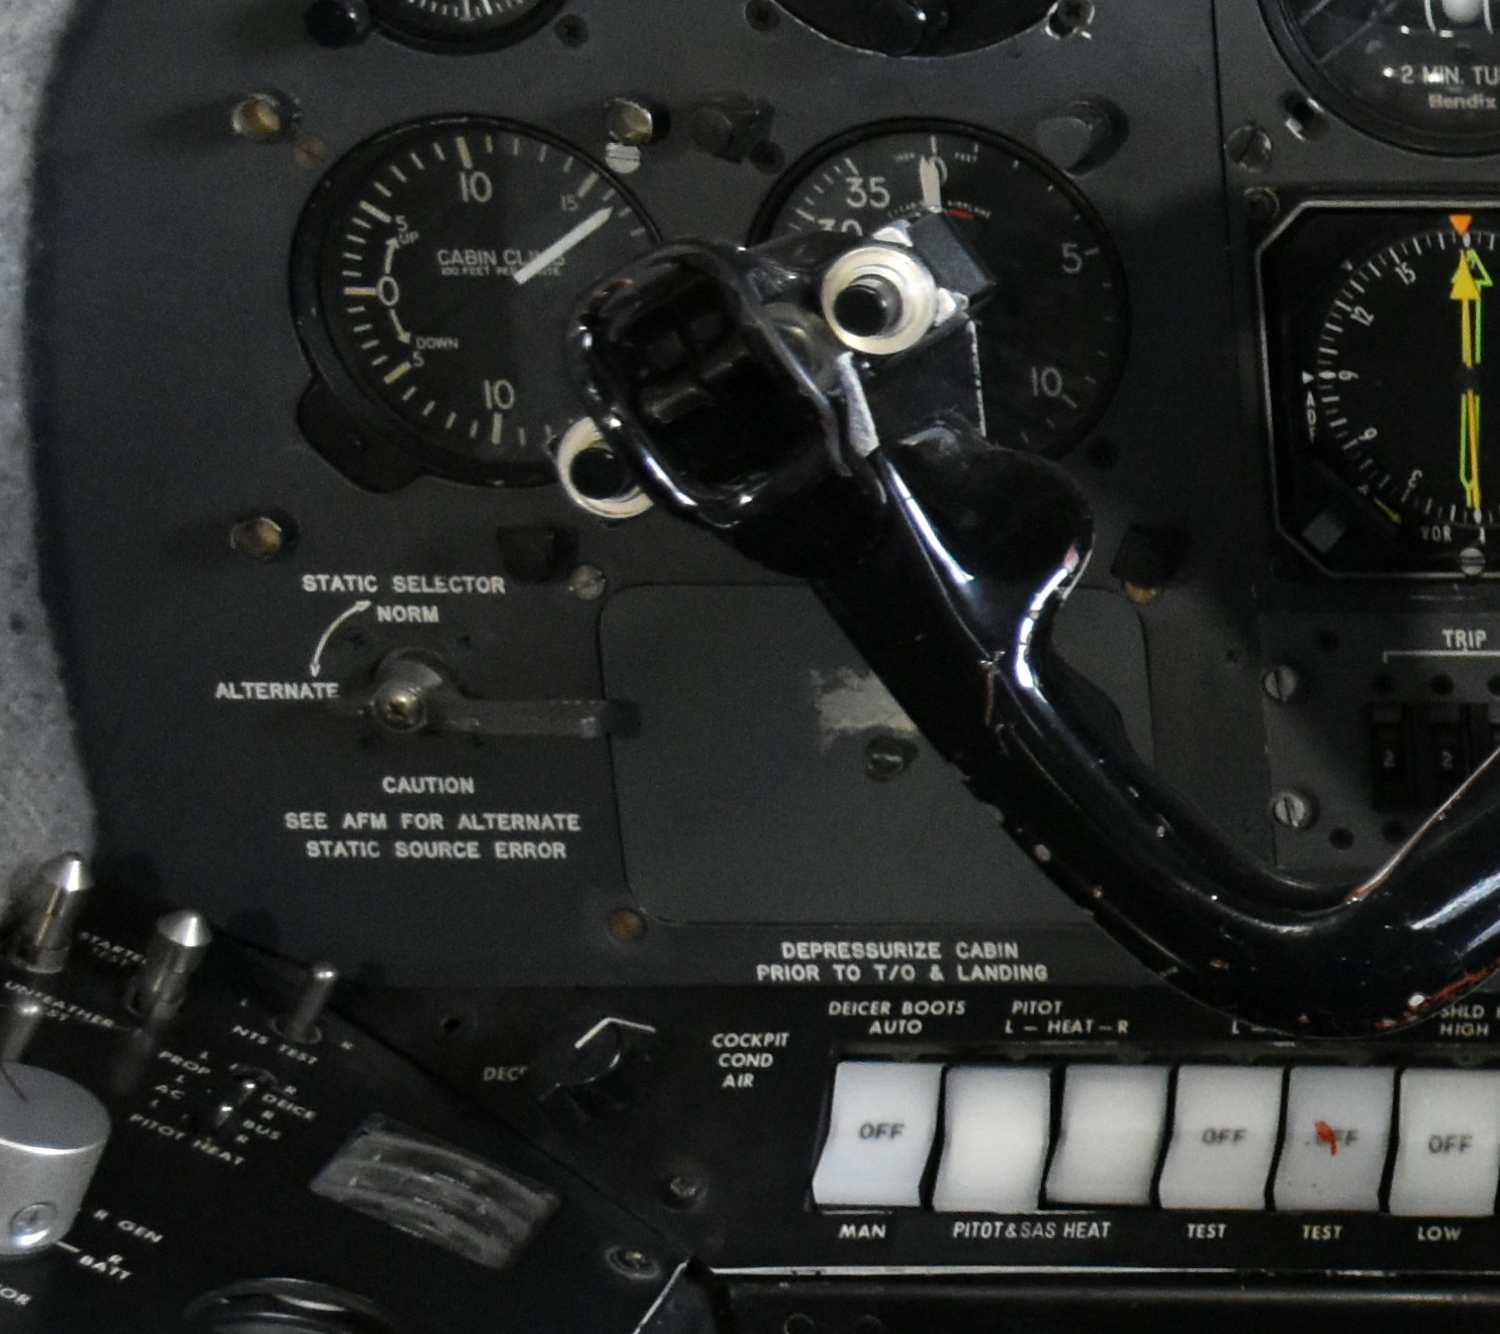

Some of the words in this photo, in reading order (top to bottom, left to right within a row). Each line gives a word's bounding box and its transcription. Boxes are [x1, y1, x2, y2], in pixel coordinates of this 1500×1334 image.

[301, 573, 378, 593] STATIC
[391, 574, 506, 594] SELECTOR
[376, 604, 440, 623] NORM
[215, 681, 339, 700] ALTERNATE
[381, 775, 475, 794] CAUTION
[284, 811, 329, 830] SEE
[342, 811, 388, 830] AFM
[400, 812, 445, 831] FOR
[457, 812, 581, 832] ALTERNATE
[305, 840, 380, 858] STATIC
[394, 840, 481, 859] SOURCE
[494, 840, 567, 860] ERROR
[781, 941, 942, 960] DEPRESSURIZE
[955, 941, 1019, 960] CABIN
[756, 963, 820, 982] PRIOR
[832, 963, 861, 982] TO
[929, 963, 944, 982] &
[956, 963, 1048, 982] LANDING
[828, 1000, 892, 1016] DEICER
[901, 1000, 966, 1016] BOOTS
[868, 1019, 923, 1035] AUTO
[711, 1032, 789, 1049] COCKPIT
